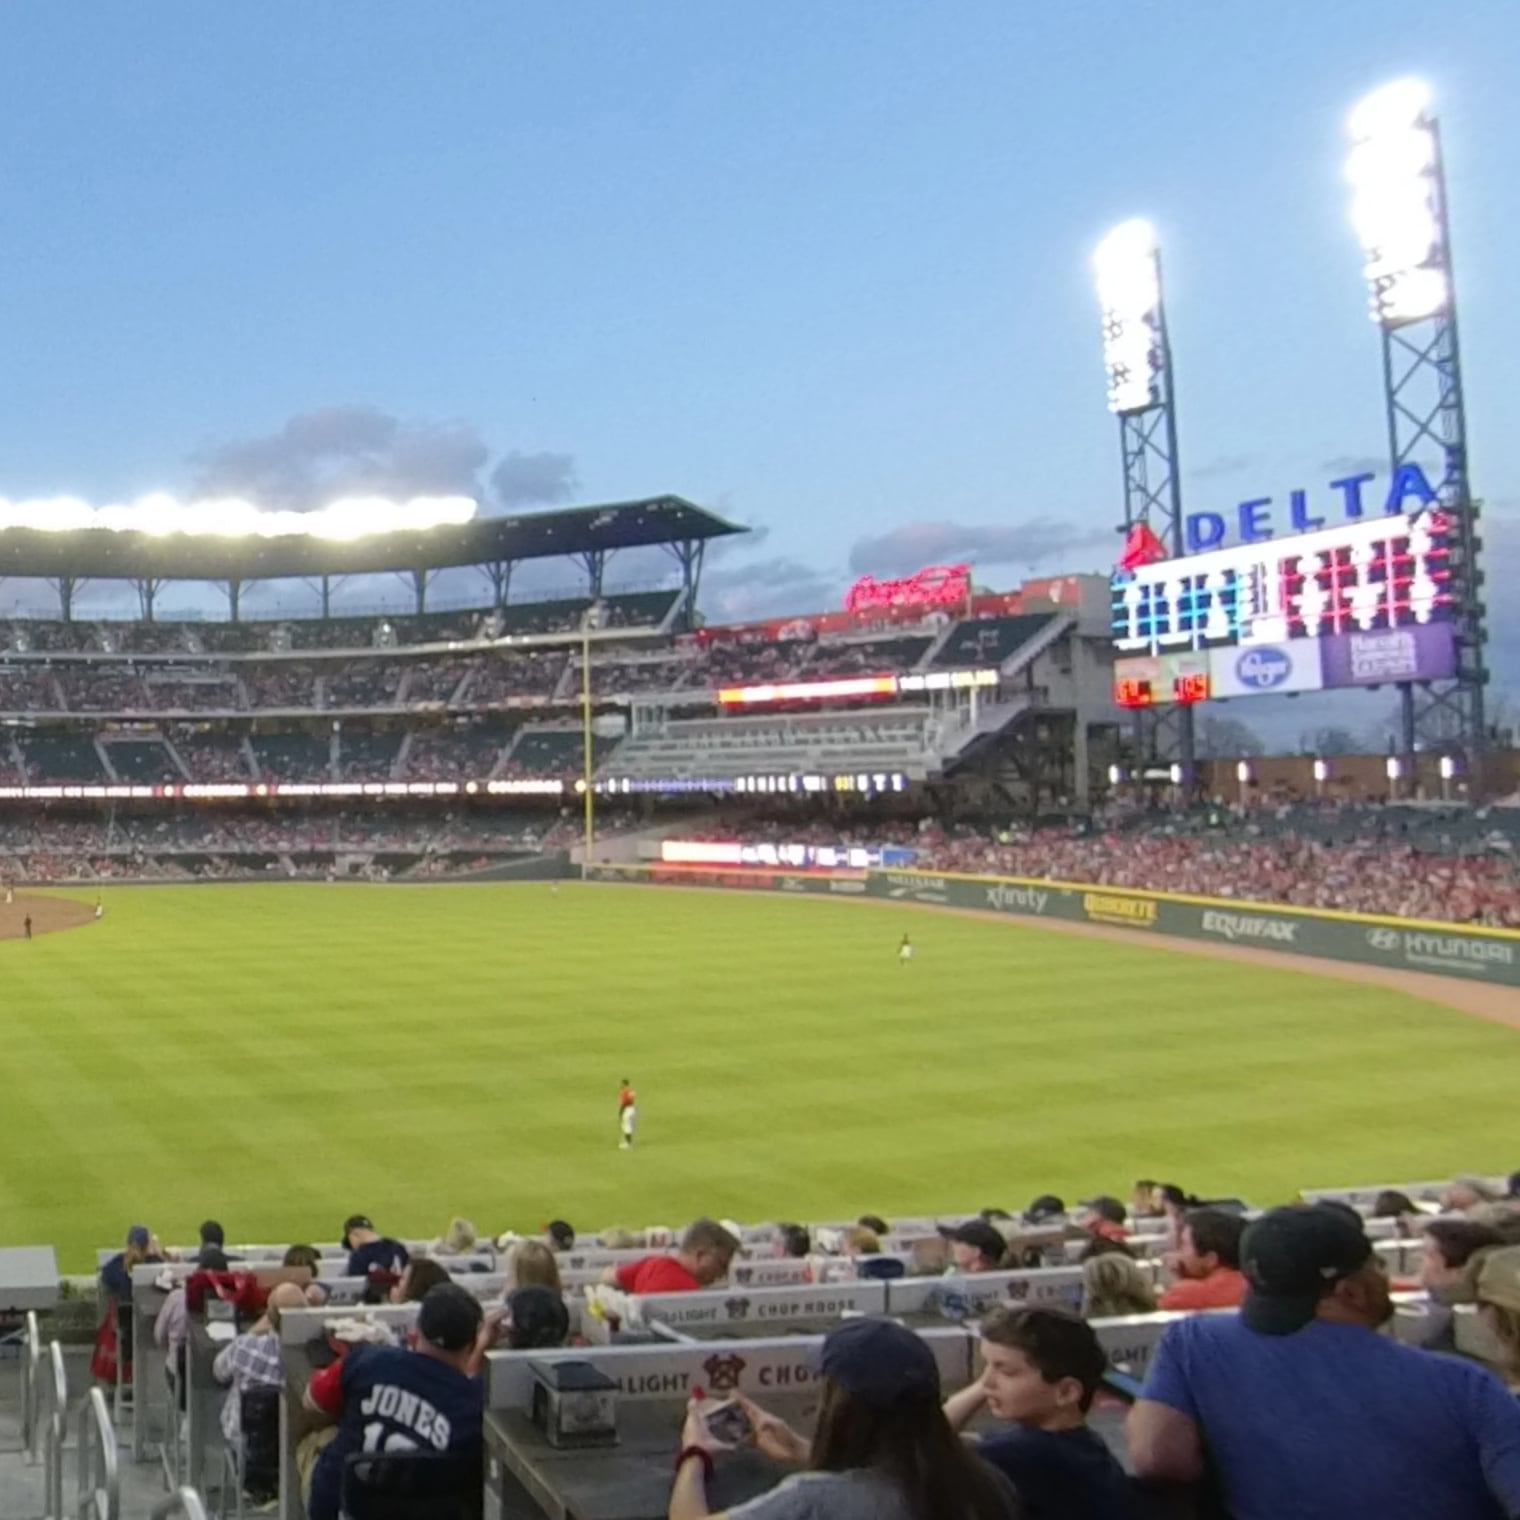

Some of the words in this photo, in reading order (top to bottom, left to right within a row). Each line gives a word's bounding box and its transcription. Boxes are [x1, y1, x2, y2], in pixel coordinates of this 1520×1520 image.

[1186, 462, 1437, 552] DELTA
[986, 882, 1048, 913] xfinity
[1201, 911, 1296, 941] EQUIFAX
[1405, 933, 1513, 964] HYUNDAI
[628, 1373, 690, 1393] LIGHT
[361, 1384, 451, 1450] JONES
